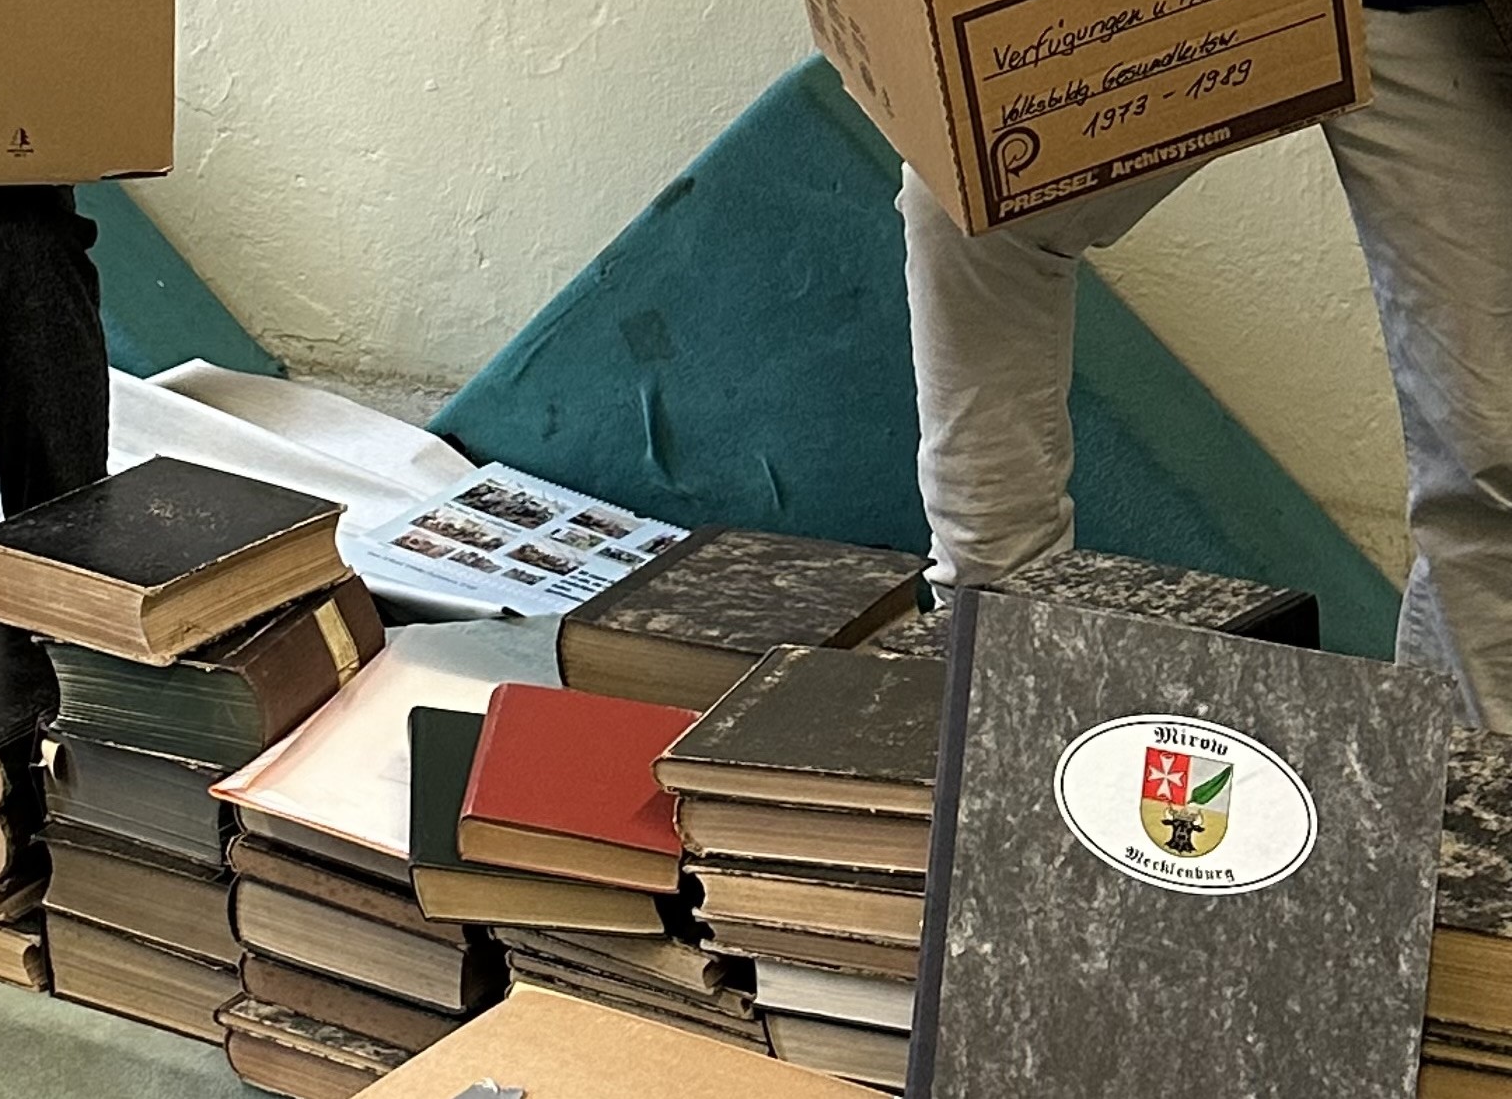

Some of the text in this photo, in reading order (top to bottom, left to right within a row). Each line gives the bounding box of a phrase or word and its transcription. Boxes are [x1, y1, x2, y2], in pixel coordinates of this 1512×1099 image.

[993, 9, 1144, 71] Verfügungen
[1082, 94, 1149, 139] 1973
[1185, 58, 1253, 100] 1989
[998, 125, 1232, 219] PRESSEL Archivsystem
[1153, 726, 1229, 756] Mirow
[1124, 846, 1236, 883] Mecklenburg
